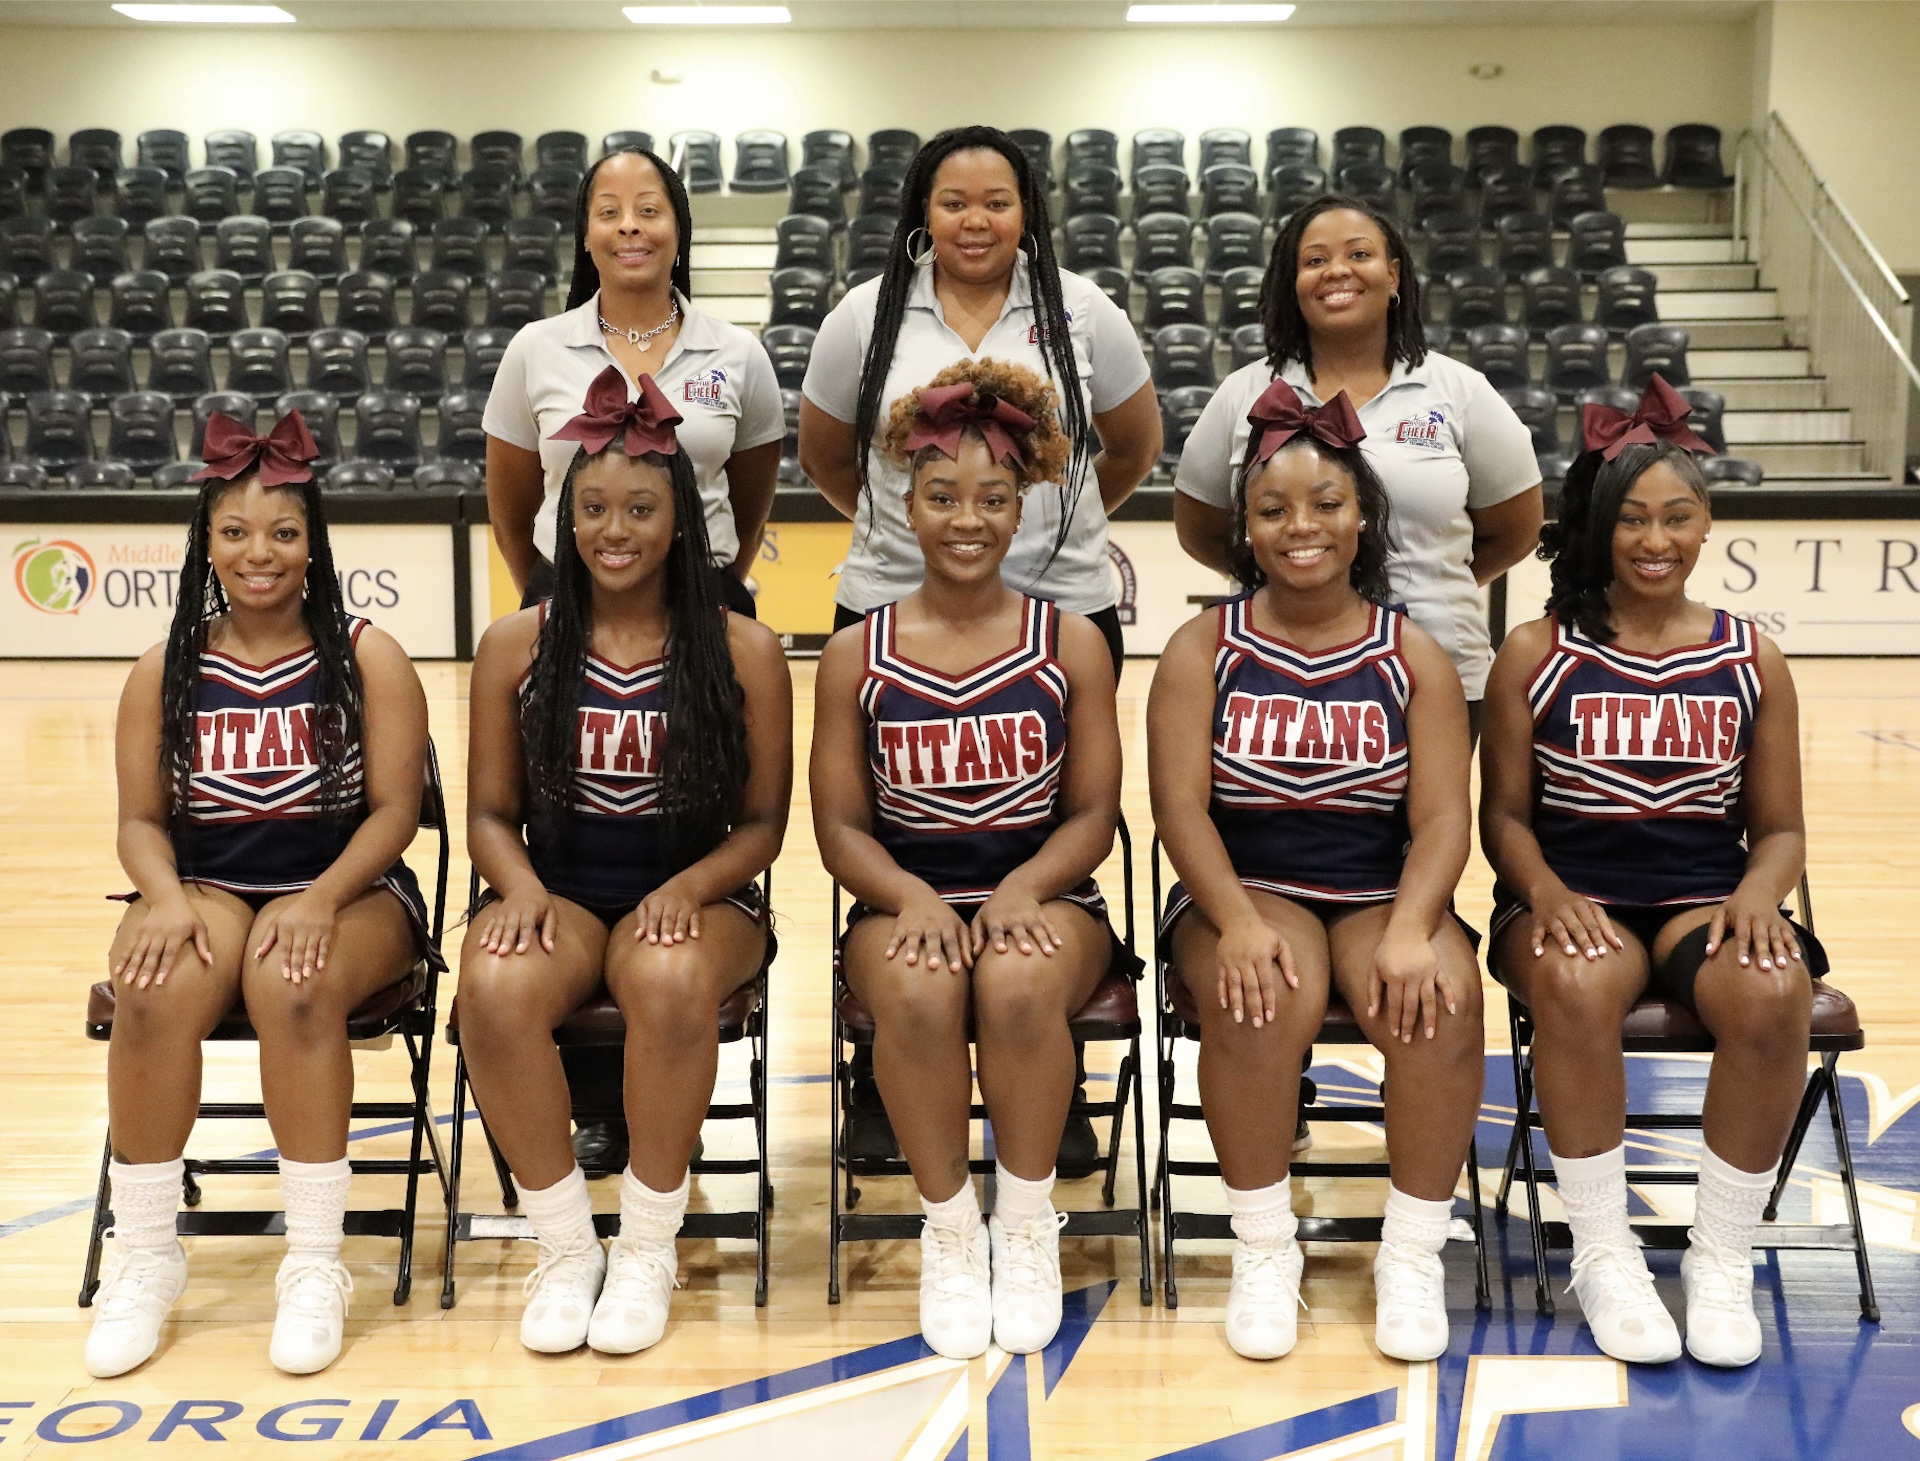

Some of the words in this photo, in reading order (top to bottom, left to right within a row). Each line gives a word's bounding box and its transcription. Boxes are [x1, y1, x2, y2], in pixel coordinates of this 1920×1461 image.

[683, 381, 721, 401] CHEER
[1396, 421, 1437, 442] CHEER
[108, 544, 182, 564] Middle
[878, 710, 1048, 788] TITANS
[1222, 690, 1390, 769] TITANS
[1570, 692, 1741, 765] TITANS
